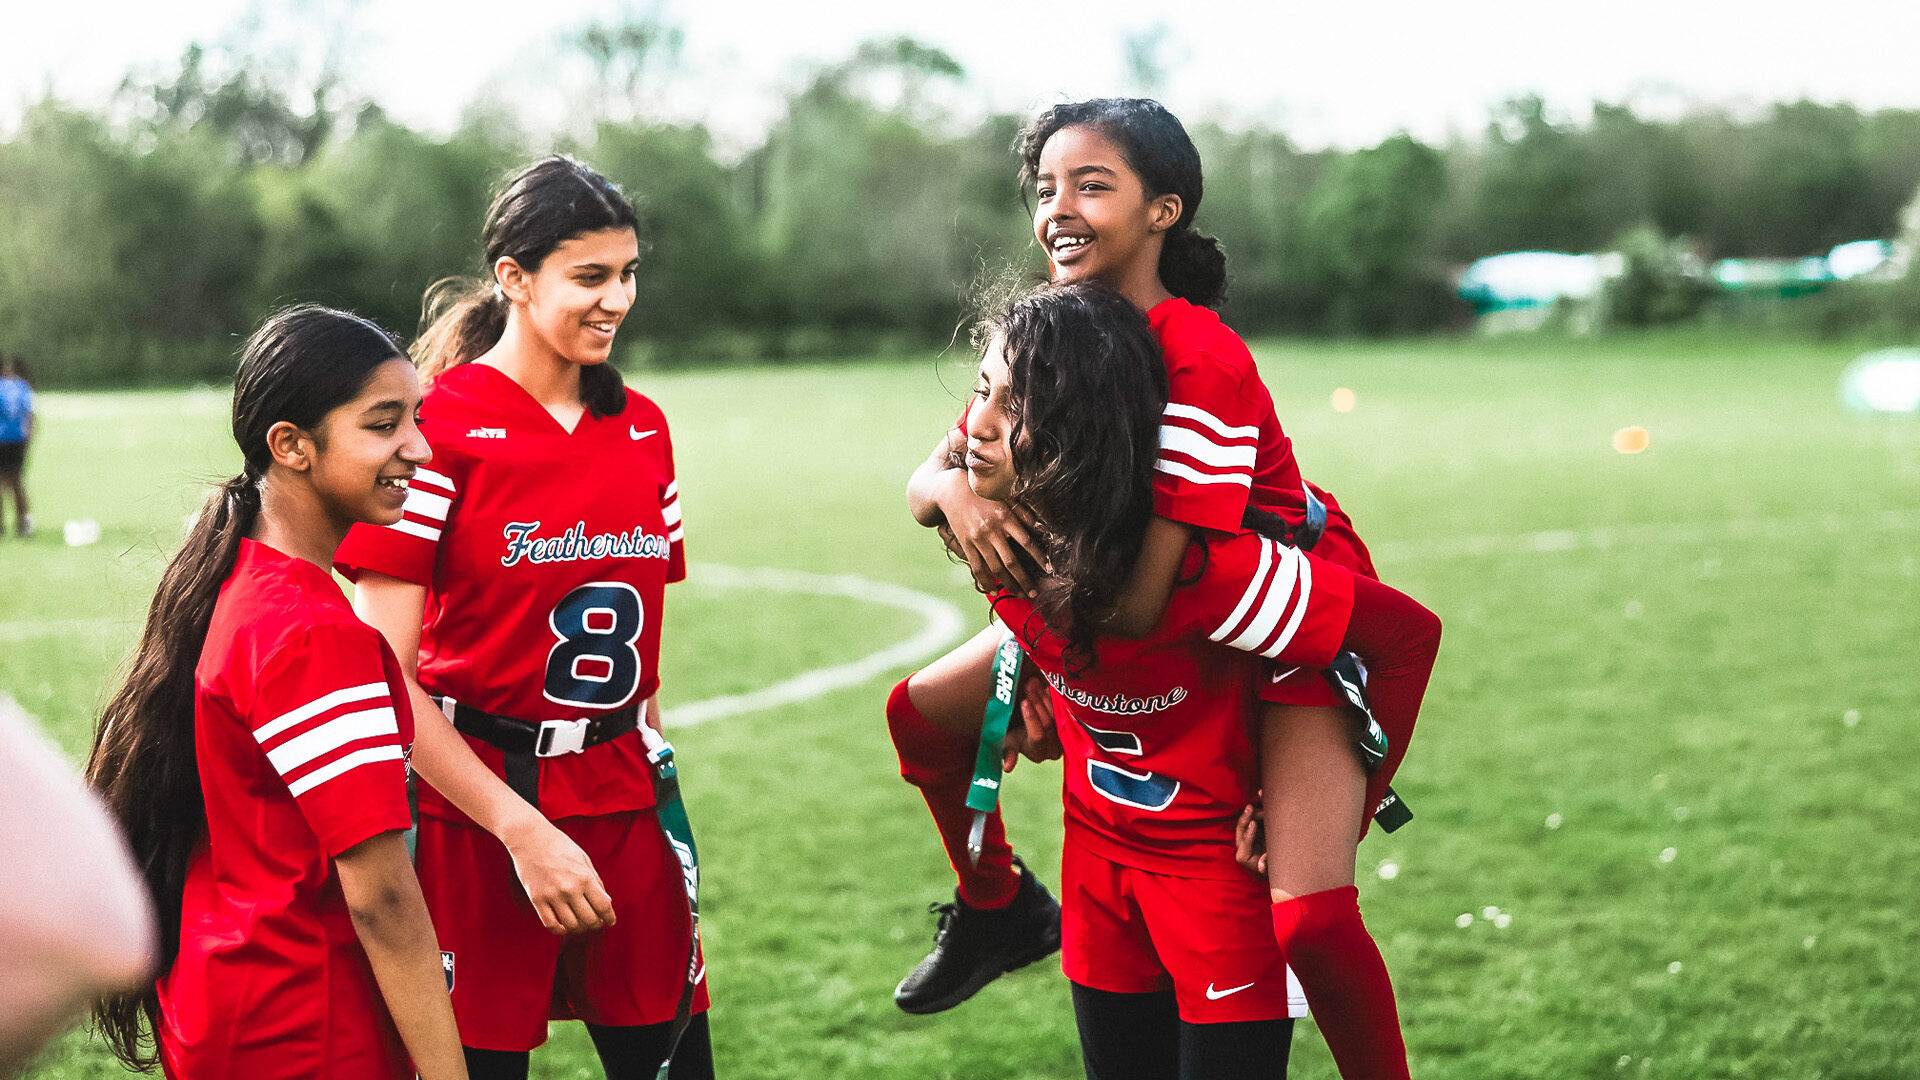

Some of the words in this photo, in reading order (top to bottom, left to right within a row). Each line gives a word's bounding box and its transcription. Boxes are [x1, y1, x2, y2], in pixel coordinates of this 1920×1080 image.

[543, 581, 644, 709] 8
[995, 649, 1018, 705] FLAG
[1048, 672, 1188, 715] therstone
